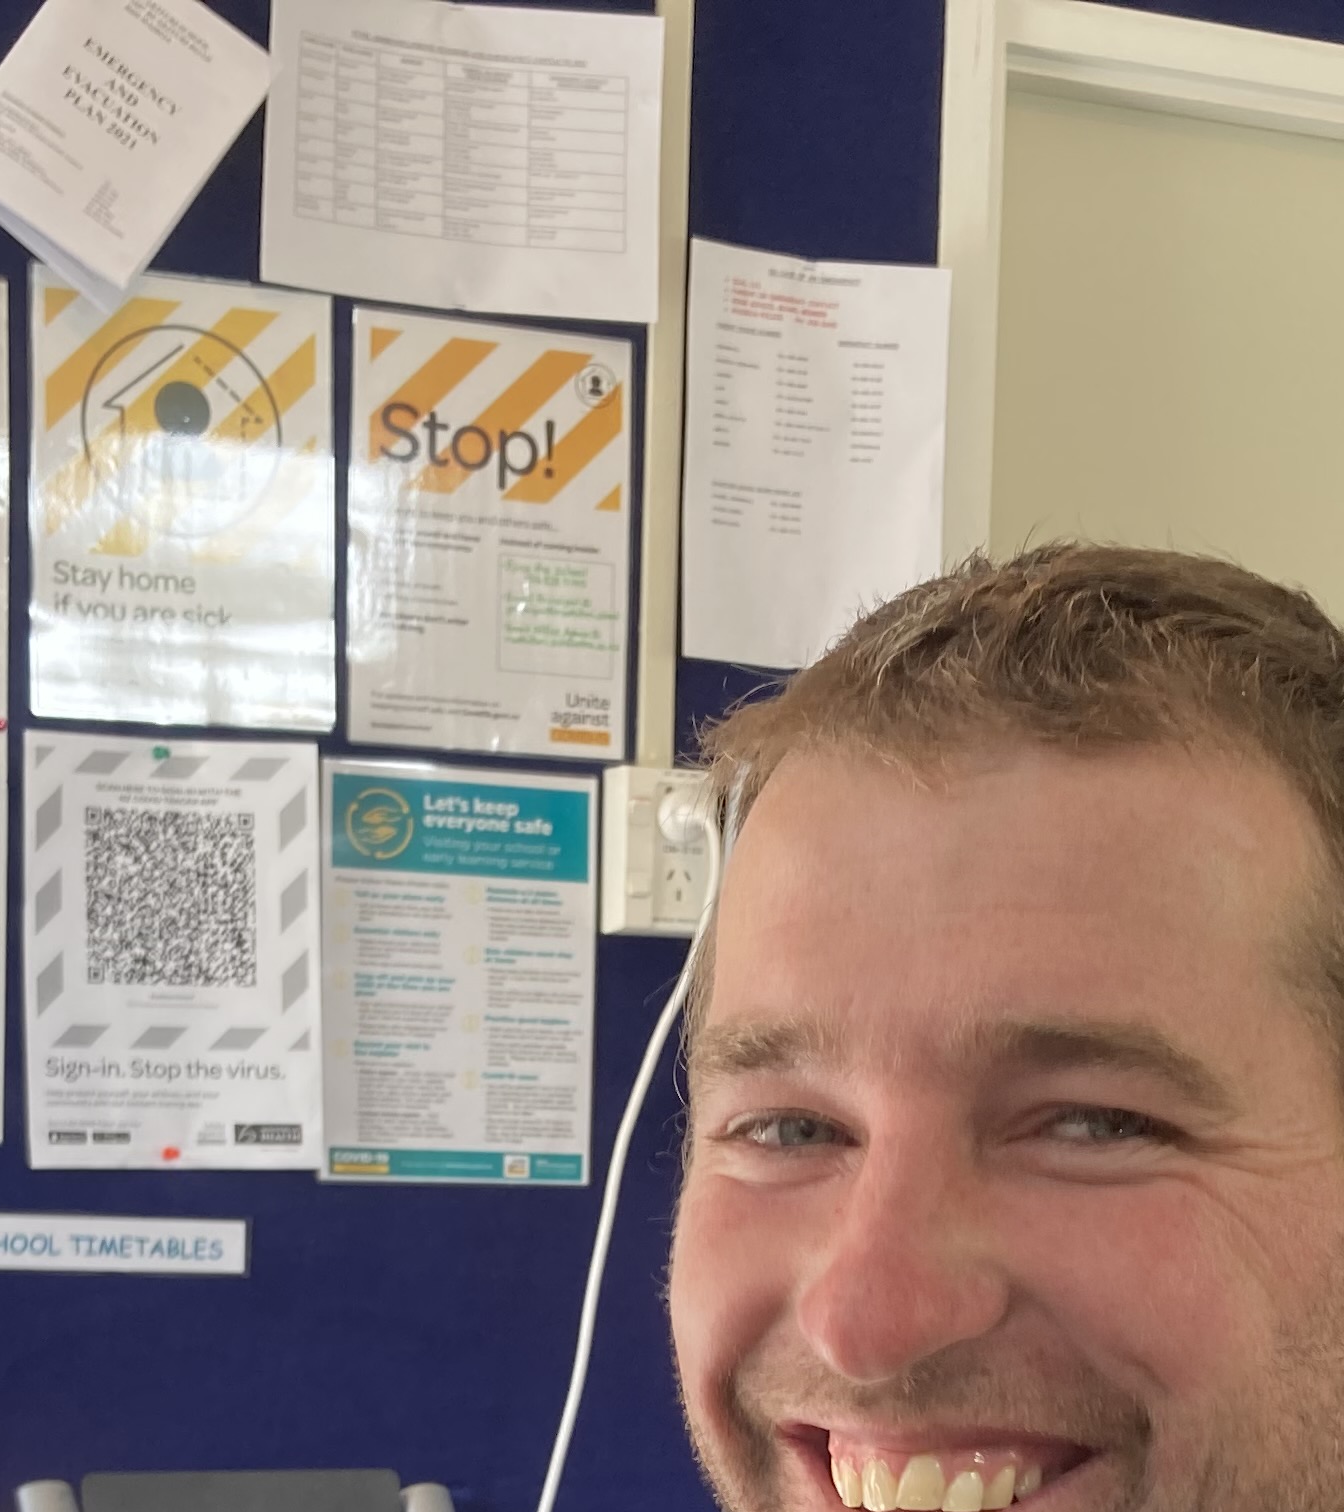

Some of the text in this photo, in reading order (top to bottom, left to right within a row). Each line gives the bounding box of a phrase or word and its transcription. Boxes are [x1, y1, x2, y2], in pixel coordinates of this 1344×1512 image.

[84, 37, 180, 116] EMERGENCY
[62, 64, 160, 144] EVACUATION
[105, 79, 140, 108] AND
[64, 88, 138, 150] PLAN 2021
[379, 402, 556, 490] Stop!
[52, 560, 196, 594] Stay home
[54, 592, 232, 627] if you are sick
[565, 692, 611, 711] Unite
[550, 710, 610, 728] against
[423, 794, 519, 819] Let's keep
[422, 814, 553, 836] everyone safe
[422, 835, 561, 855] Visiting your school or
[422, 852, 554, 871] early learning service
[45, 1057, 287, 1083] Sign-in. Stop the virus.
[69, 1234, 224, 1261] TIMETABLES
